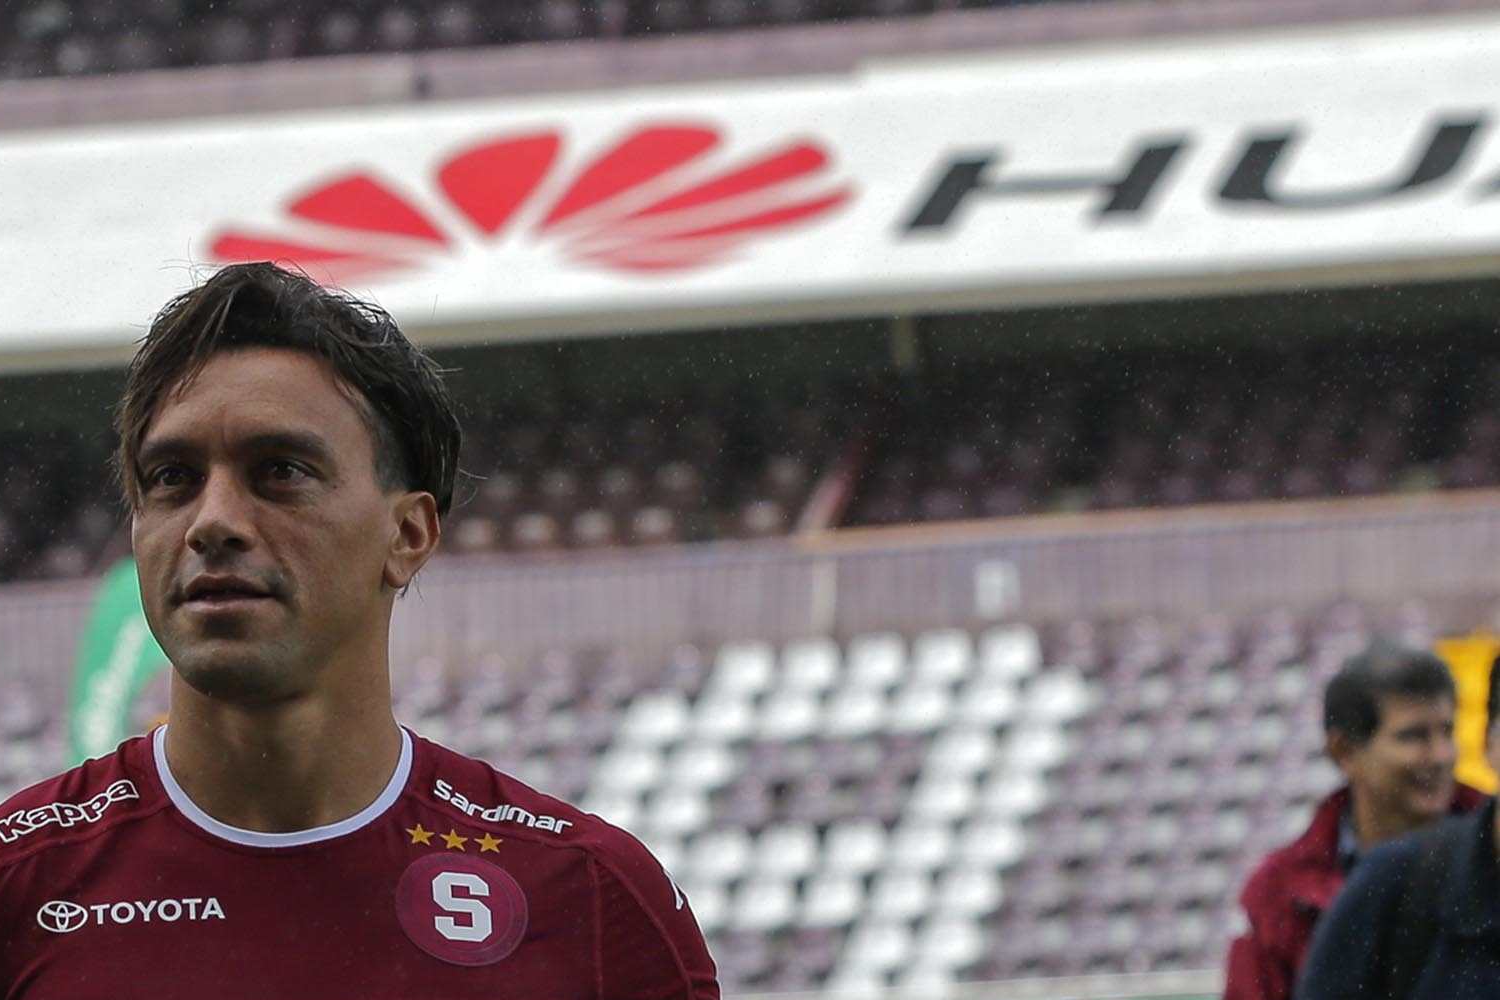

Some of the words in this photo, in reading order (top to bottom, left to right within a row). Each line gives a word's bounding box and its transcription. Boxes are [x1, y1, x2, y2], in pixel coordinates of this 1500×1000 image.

[892, 112, 1500, 238] HU
[90, 897, 225, 924] TOYOTA
[432, 872, 492, 942] S
